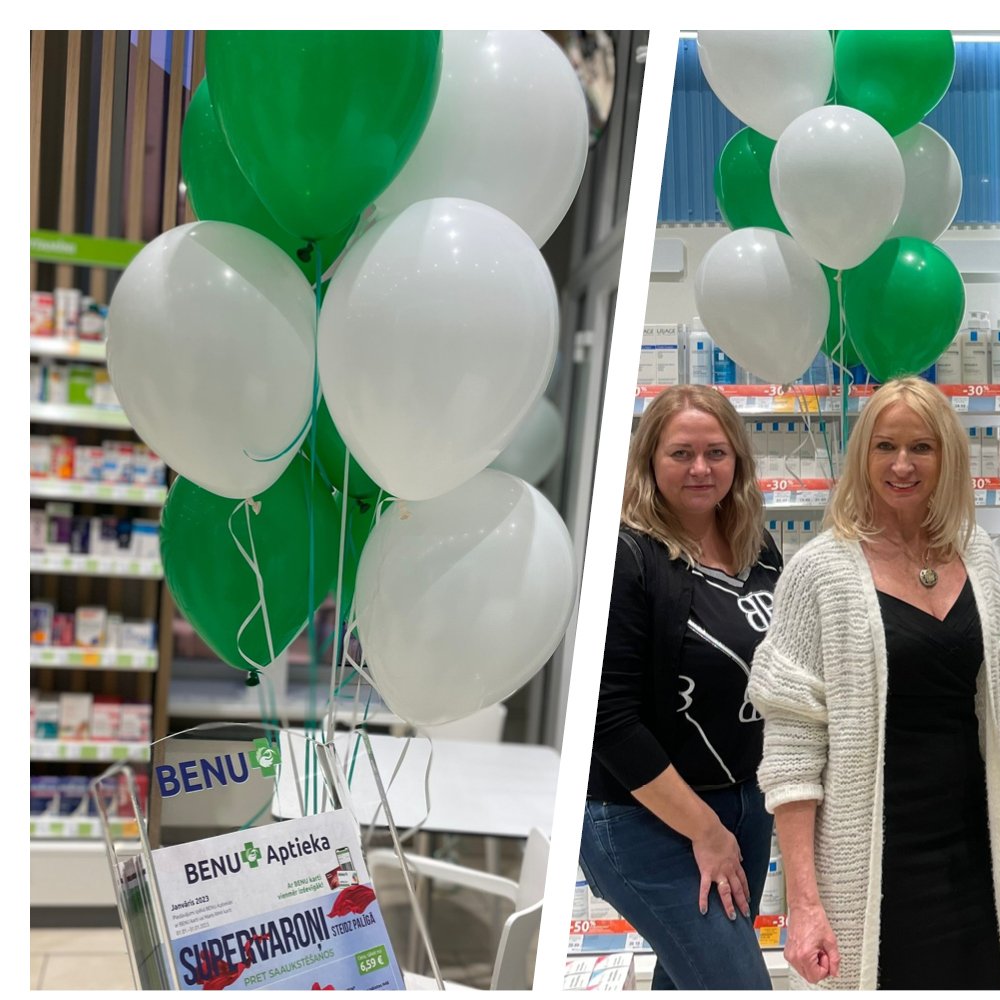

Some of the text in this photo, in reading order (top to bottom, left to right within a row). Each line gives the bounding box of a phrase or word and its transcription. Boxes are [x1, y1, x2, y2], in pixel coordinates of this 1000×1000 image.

[963, 385, 990, 396] -30%
[766, 479, 794, 490] -30%
[155, 752, 250, 798] BENU
[184, 833, 331, 885] BENU Aptieka
[171, 899, 195, 912] Janvāris
[195, 895, 210, 904] 2023
[179, 906, 331, 986] SUPERVAROŅI
[331, 920, 353, 937] STEIDZ
[352, 911, 376, 931] PALĪGĀ
[244, 948, 335, 986] PRET SAAUKSTĒŠANOS
[360, 954, 385, 972] 6,59 €
